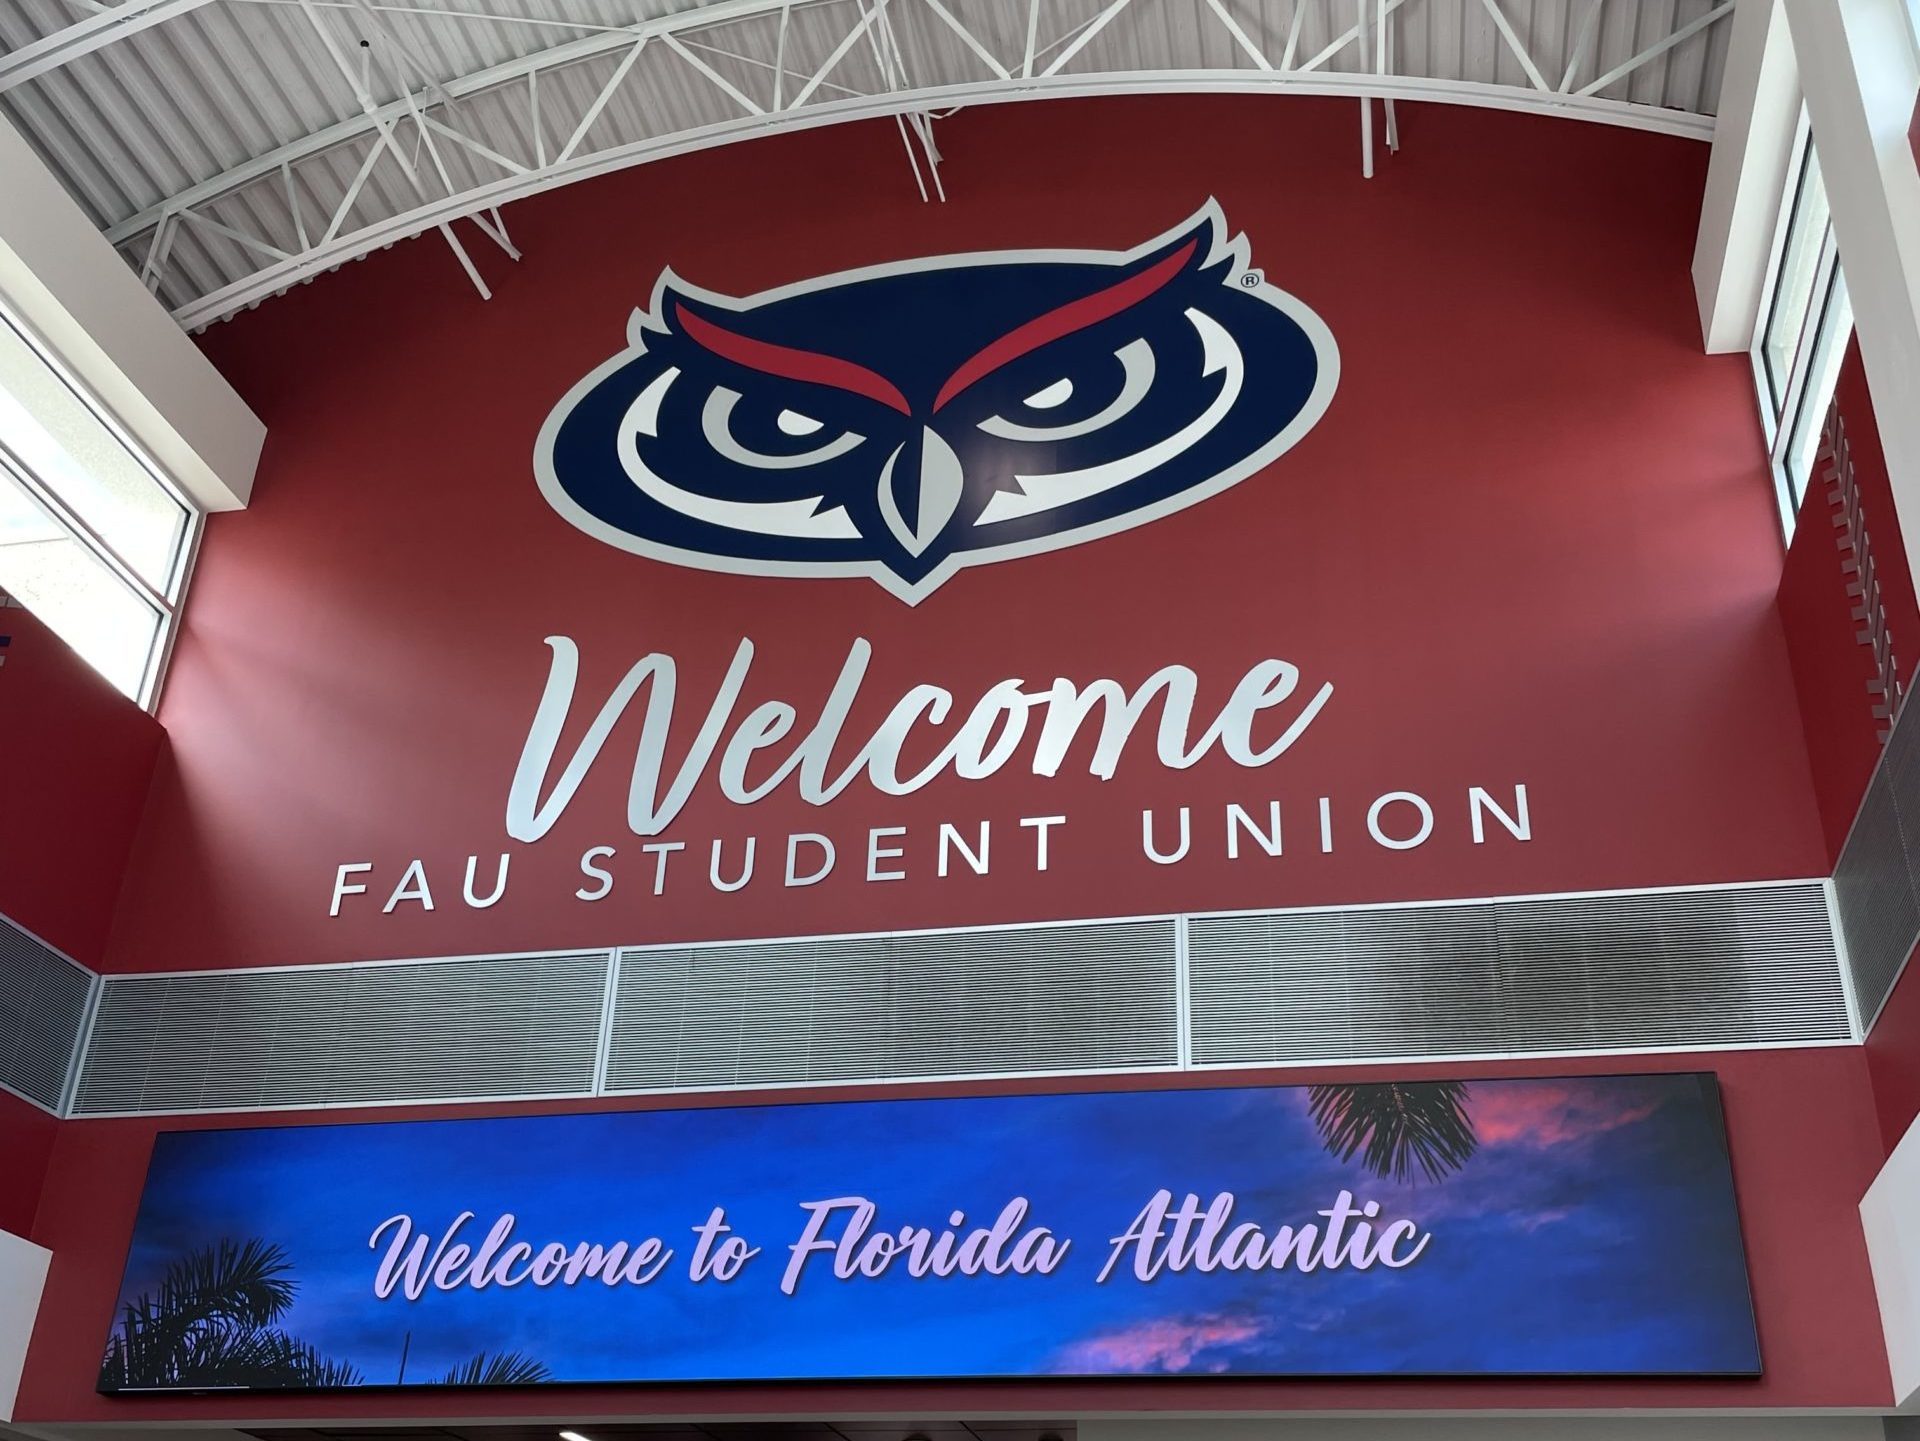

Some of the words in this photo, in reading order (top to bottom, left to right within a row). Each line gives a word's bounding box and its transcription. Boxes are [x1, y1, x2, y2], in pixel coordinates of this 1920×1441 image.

[506, 635, 1334, 843] Welcome
[329, 853, 512, 917] FAU
[575, 815, 1067, 901] STUDENT
[1142, 783, 1532, 865] UNION
[368, 1211, 675, 1301] Welcome
[689, 1207, 762, 1283] to
[780, 1196, 1072, 1295] Florida
[1095, 1188, 1431, 1284] Atlantic
